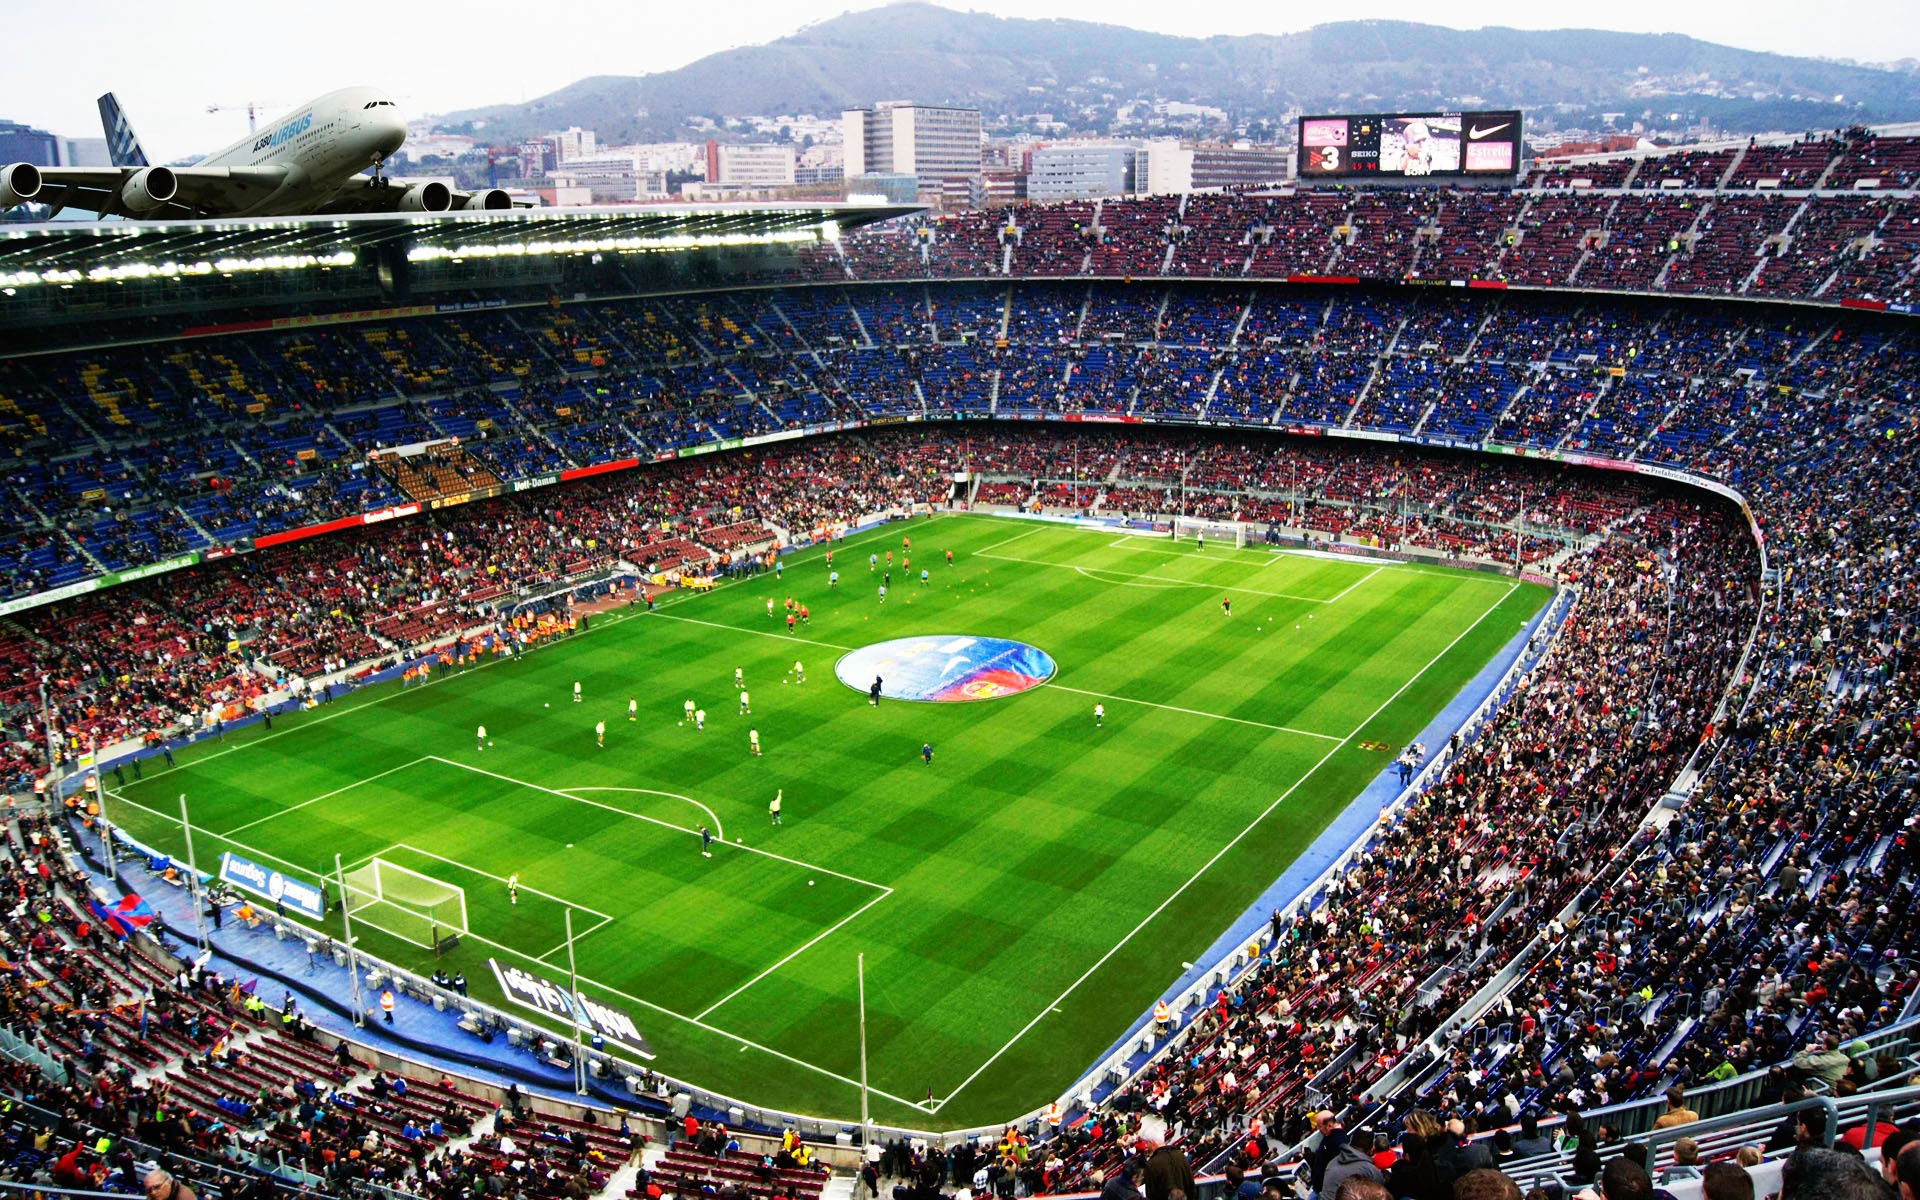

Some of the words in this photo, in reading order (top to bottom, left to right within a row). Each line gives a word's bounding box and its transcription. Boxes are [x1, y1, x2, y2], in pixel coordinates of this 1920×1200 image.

[269, 113, 313, 149] AIRBUS
[1321, 146, 1339, 170] 3
[1469, 144, 1511, 157] Estrella
[1405, 168, 1432, 176] SONY
[514, 477, 556, 491] Voll-Damm
[229, 860, 266, 888] Seguros
